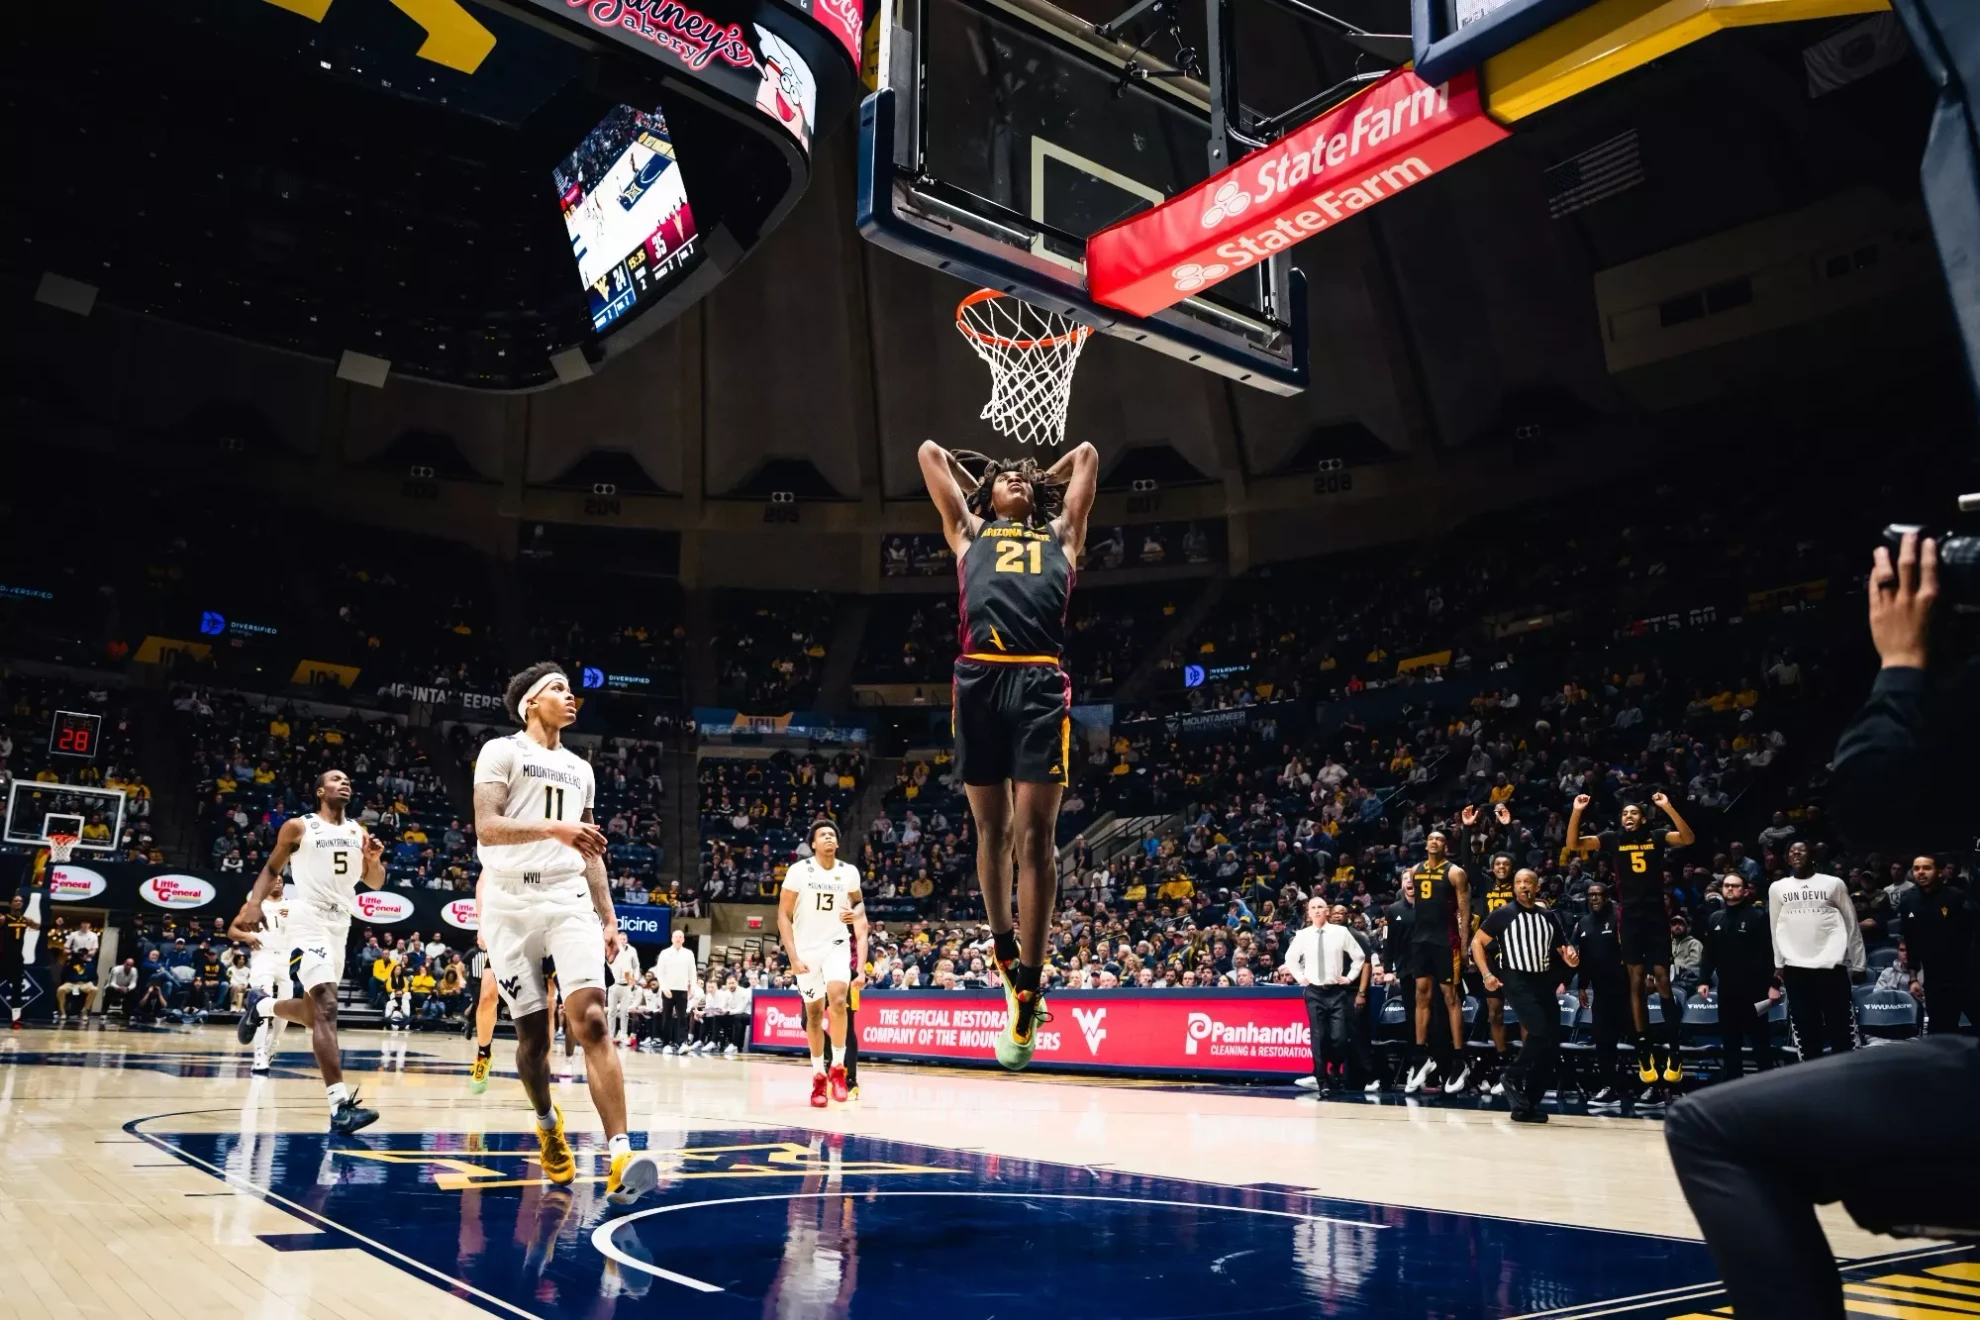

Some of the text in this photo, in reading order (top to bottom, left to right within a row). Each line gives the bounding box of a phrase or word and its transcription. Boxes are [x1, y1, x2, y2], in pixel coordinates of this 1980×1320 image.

[651, 231, 667, 259] 35
[613, 264, 627, 292] 24
[1314, 473, 1352, 494] 208
[981, 527, 1022, 538] ARIZONA
[995, 540, 1042, 574] 21
[230, 621, 277, 635] DIVERSIFIED
[608, 674, 650, 684] DIVERSIFIED
[1183, 711, 1246, 725] MOUNTAINEER
[58, 728, 88, 751] 28
[523, 764, 581, 790] MOUNTAINEERS
[545, 785, 564, 821] 11
[334, 851, 348, 875] 5
[1631, 852, 1646, 873] 5
[152, 879, 179, 892] Little
[524, 872, 540, 884] WVU
[158, 888, 201, 901] General
[1420, 880, 1432, 899] 9
[1783, 890, 1829, 902] SUN DEVIL
[358, 896, 381, 907] Little
[452, 903, 474, 914] Little
[816, 892, 834, 911] 13
[363, 904, 401, 917] General
[617, 916, 657, 933] dicine
[880, 1009, 1007, 1027] THE OFFICIAL RESTORA
[863, 1029, 915, 1044] COMPANY
[918, 1030, 933, 1045] OF
[936, 1031, 957, 1046] THE
[1211, 1021, 1311, 1044] Panhandle
[1210, 1045, 1313, 1058] CLEANING & RESTORATION
